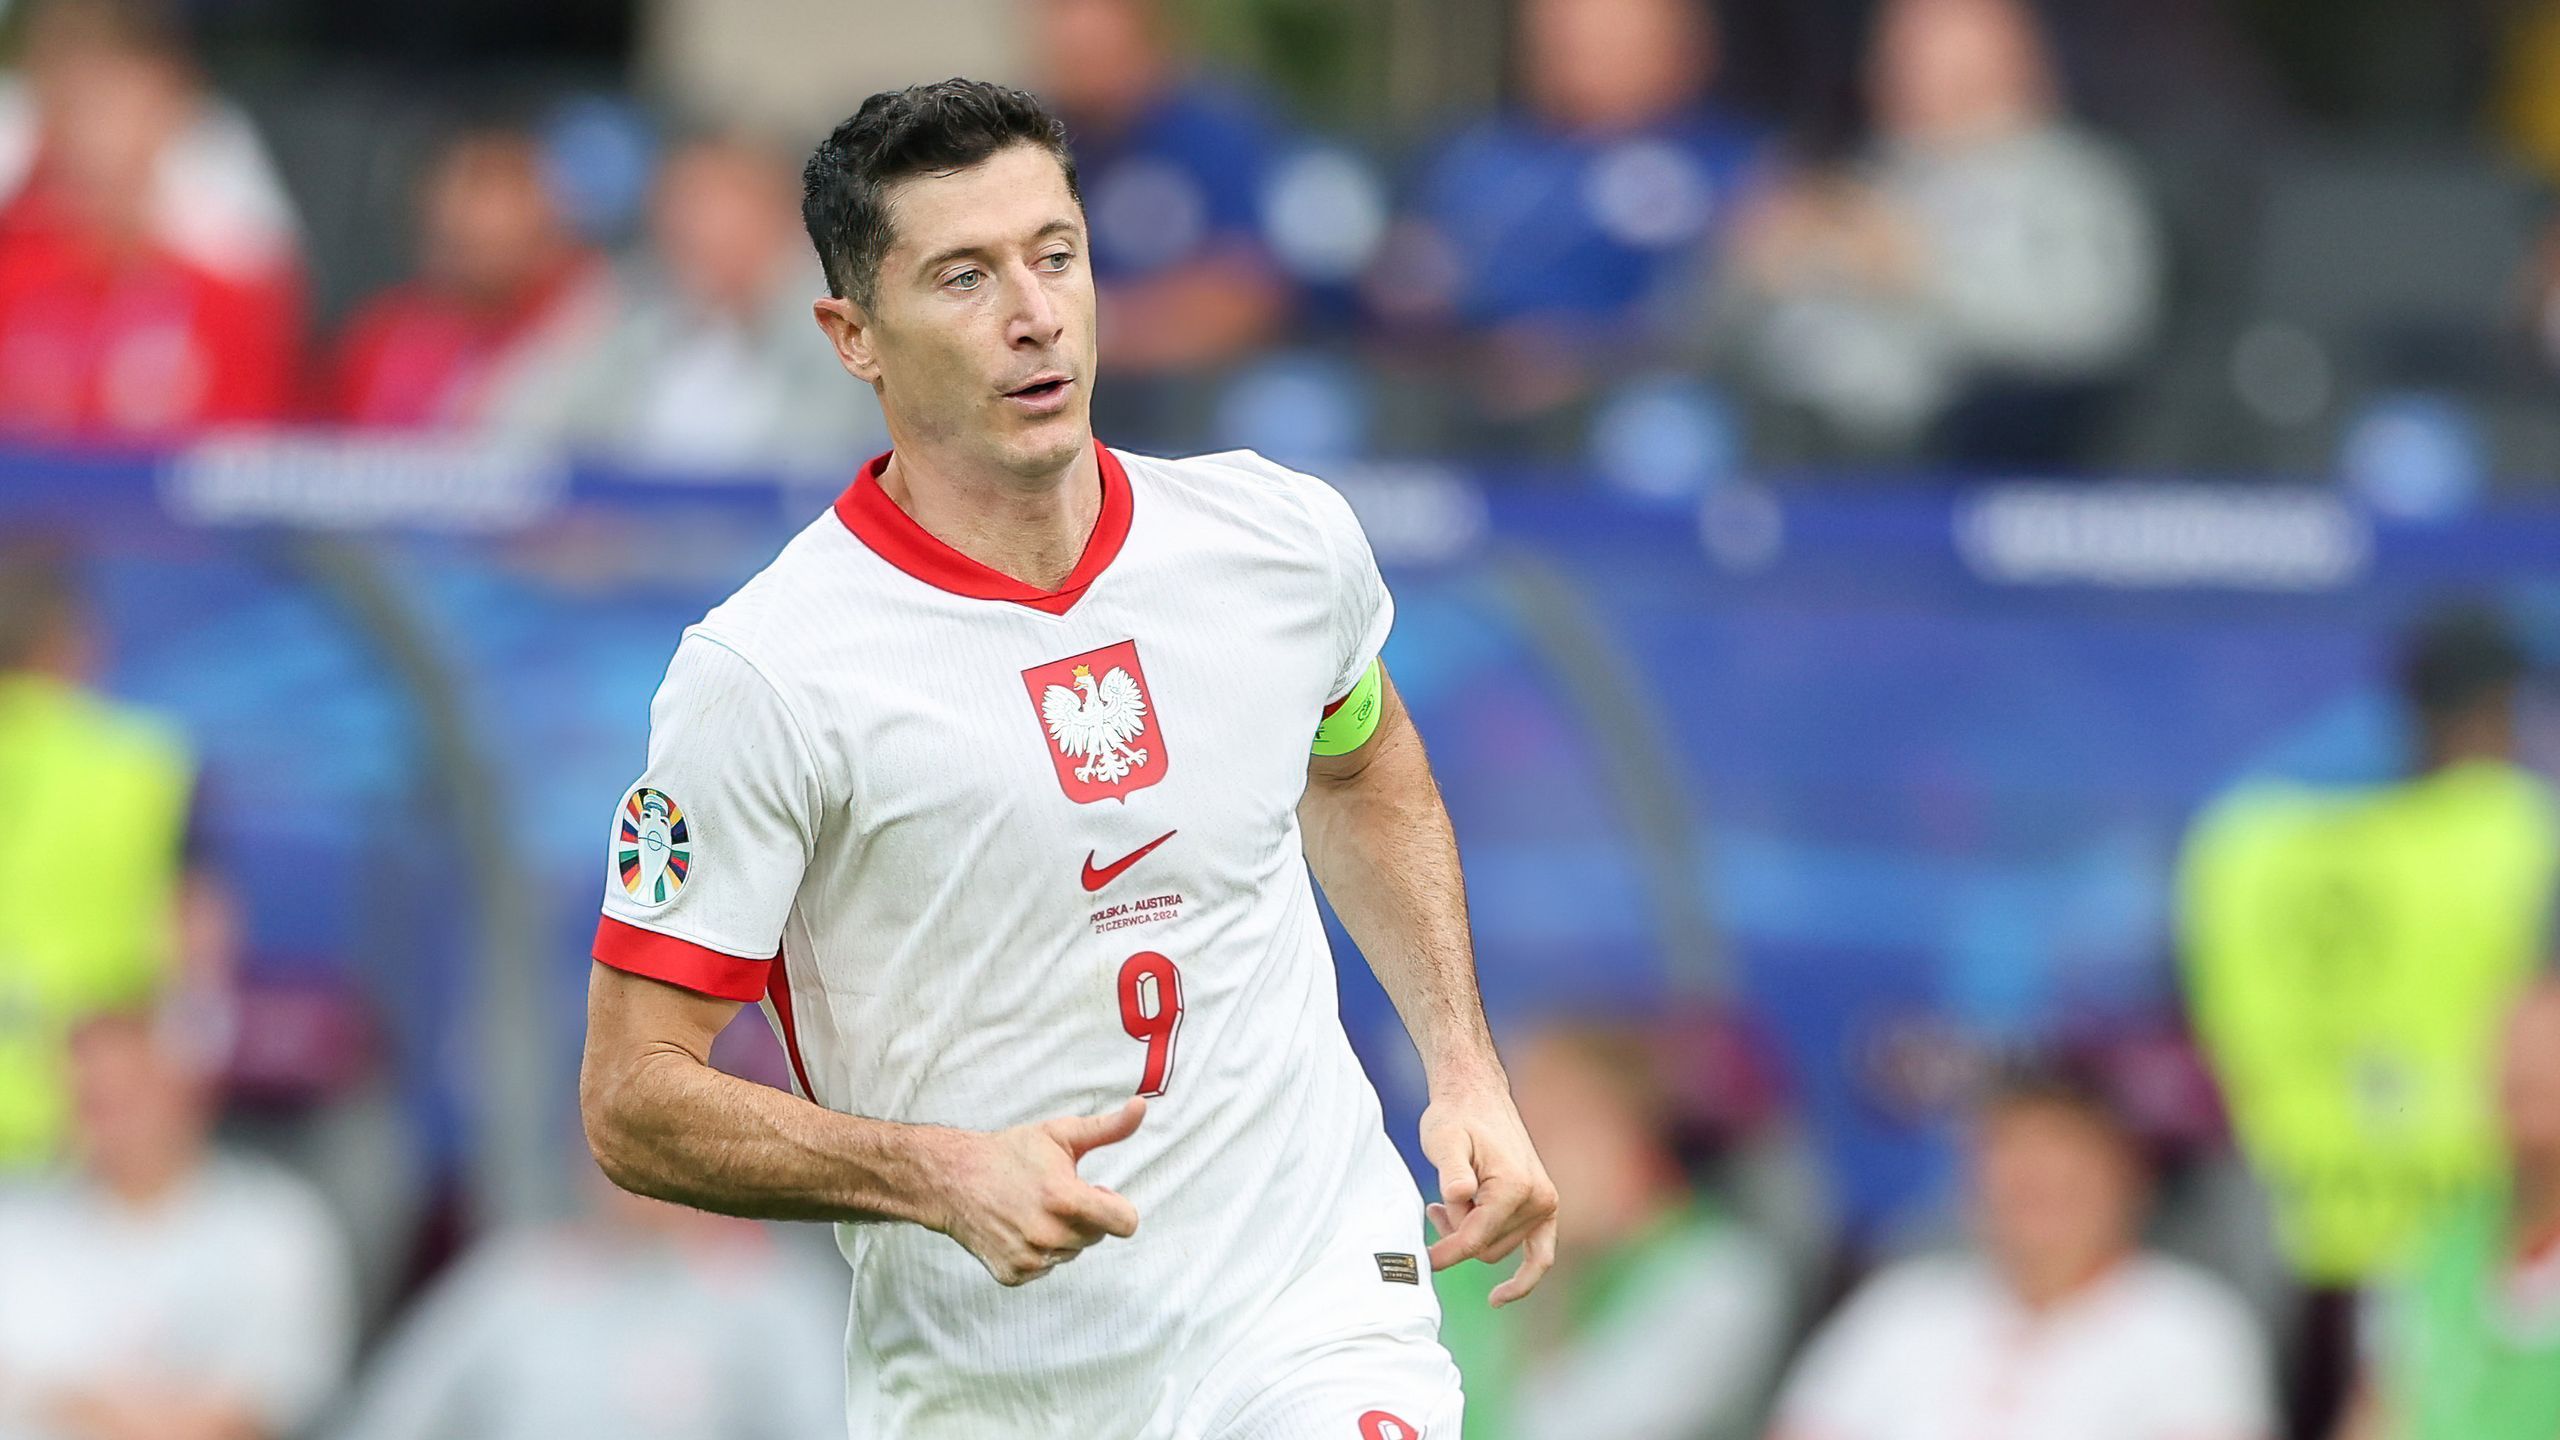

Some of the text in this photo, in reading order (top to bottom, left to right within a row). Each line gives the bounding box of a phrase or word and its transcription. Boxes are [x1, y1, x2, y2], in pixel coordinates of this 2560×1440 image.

[1134, 894, 1183, 912] AUSTRIA
[1095, 910, 1179, 934] 21 CZERWCA 2024
[1117, 951, 1184, 1099] 9
